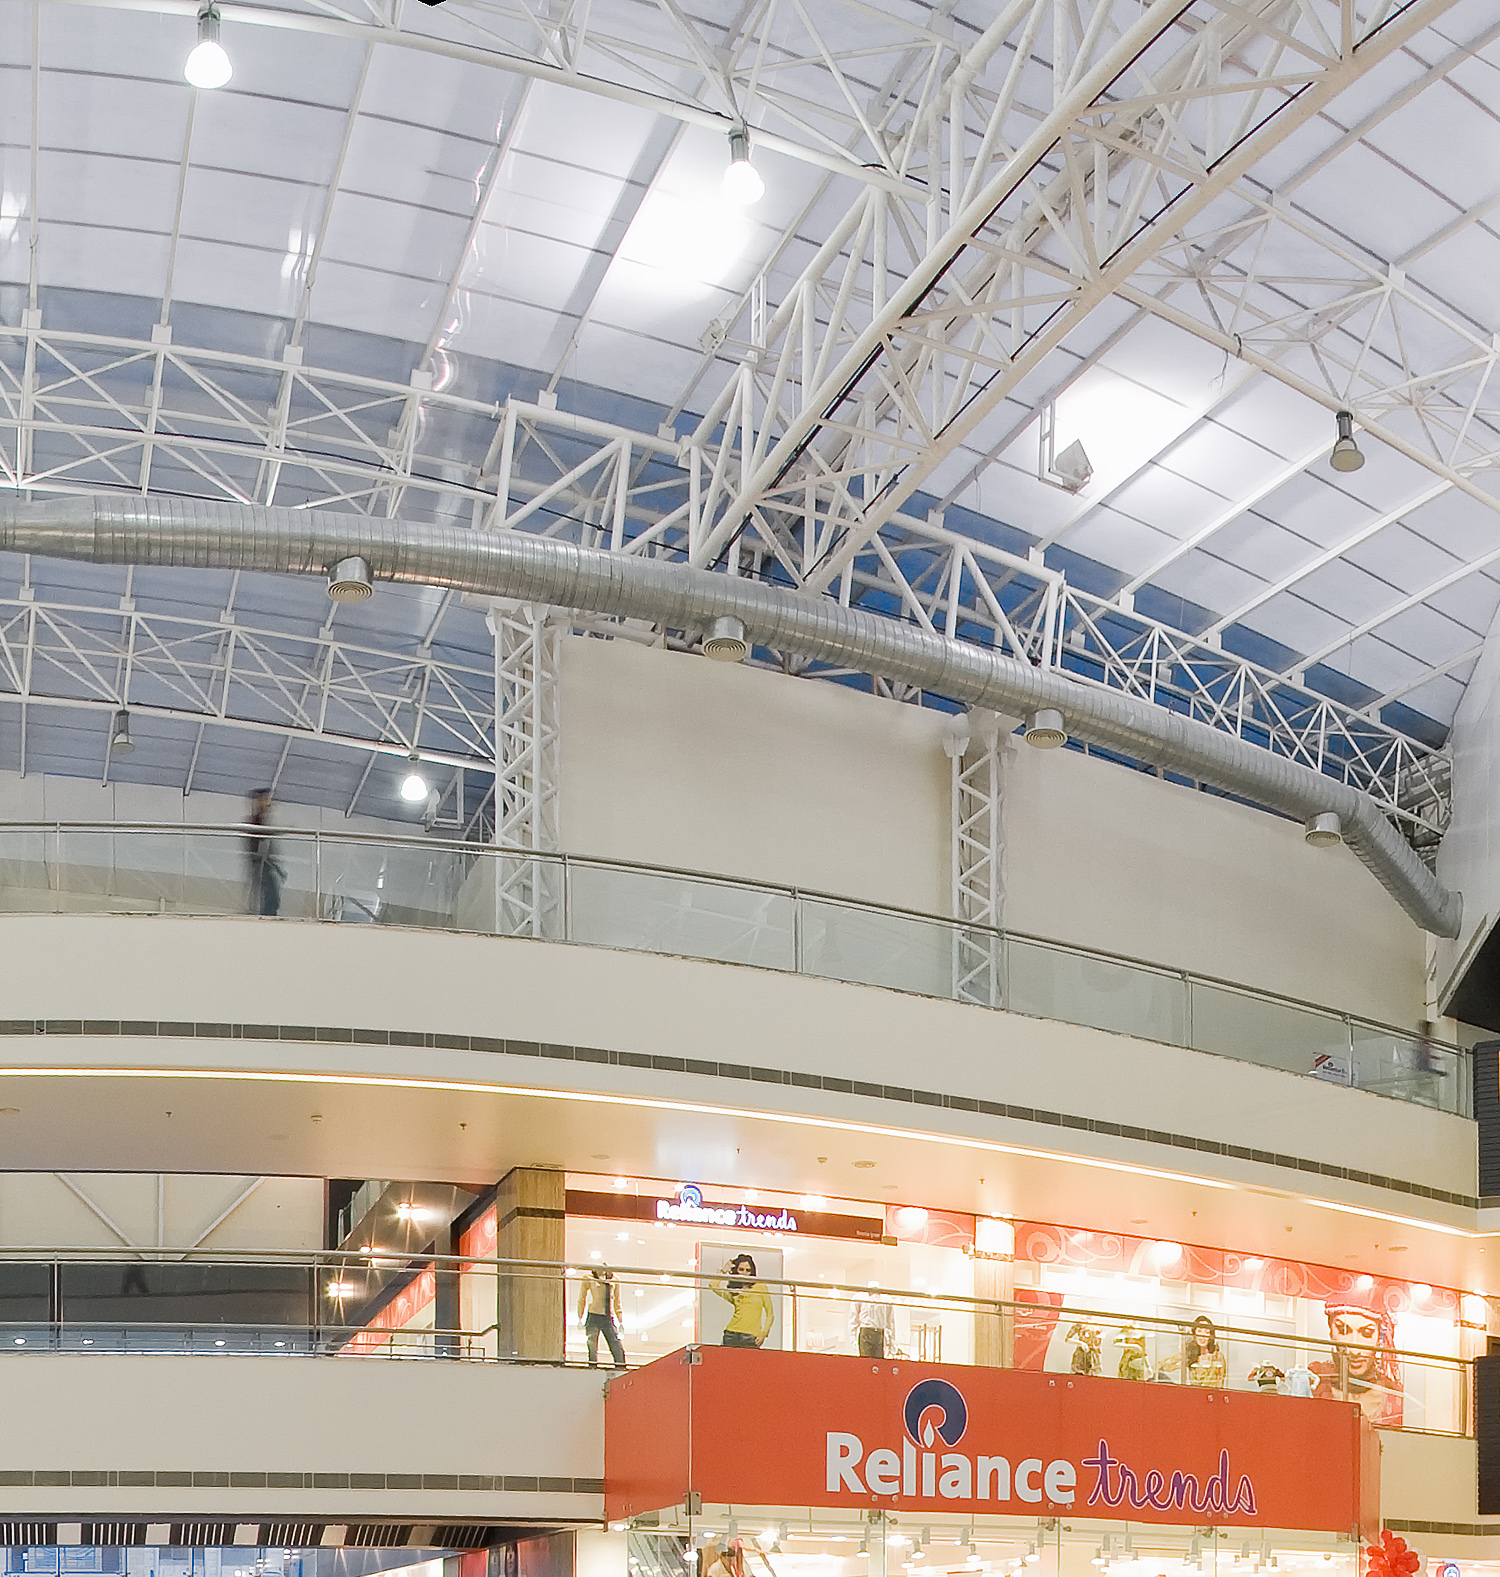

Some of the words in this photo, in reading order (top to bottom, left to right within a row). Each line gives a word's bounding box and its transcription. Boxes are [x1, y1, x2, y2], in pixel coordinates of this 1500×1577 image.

[736, 1204, 798, 1231] trends
[825, 1431, 1076, 1503] Reliance
[1081, 1439, 1258, 1515] trends
